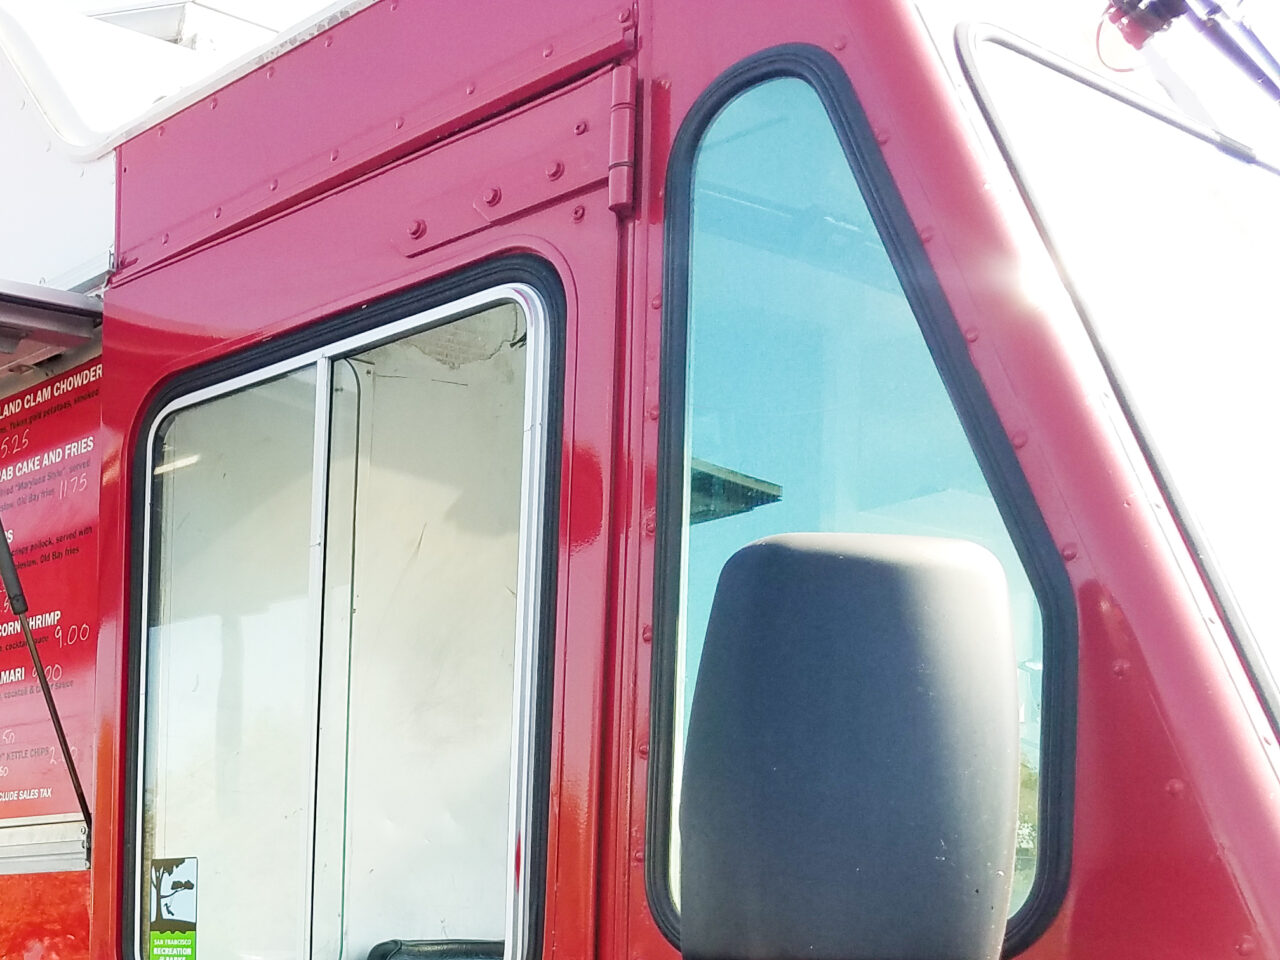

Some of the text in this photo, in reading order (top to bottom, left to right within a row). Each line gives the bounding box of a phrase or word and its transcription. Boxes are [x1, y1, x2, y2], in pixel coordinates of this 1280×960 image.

[24, 386, 51, 409] CLAM
[53, 363, 103, 397] CHOWDER
[0, 429, 29, 459] 5.25
[16, 456, 40, 477] CAKE
[42, 448, 63, 468] AND
[65, 436, 94, 459] FRIES
[55, 529, 78, 544] served
[26, 610, 61, 631] HRIMP
[55, 624, 90, 649] 9.00
[7, 750, 28, 760] KETTLE
[30, 747, 50, 758] CHIPS
[19, 789, 39, 800] SALES
[39, 788, 52, 798] TAX
[153, 947, 192, 956] RECREATION
